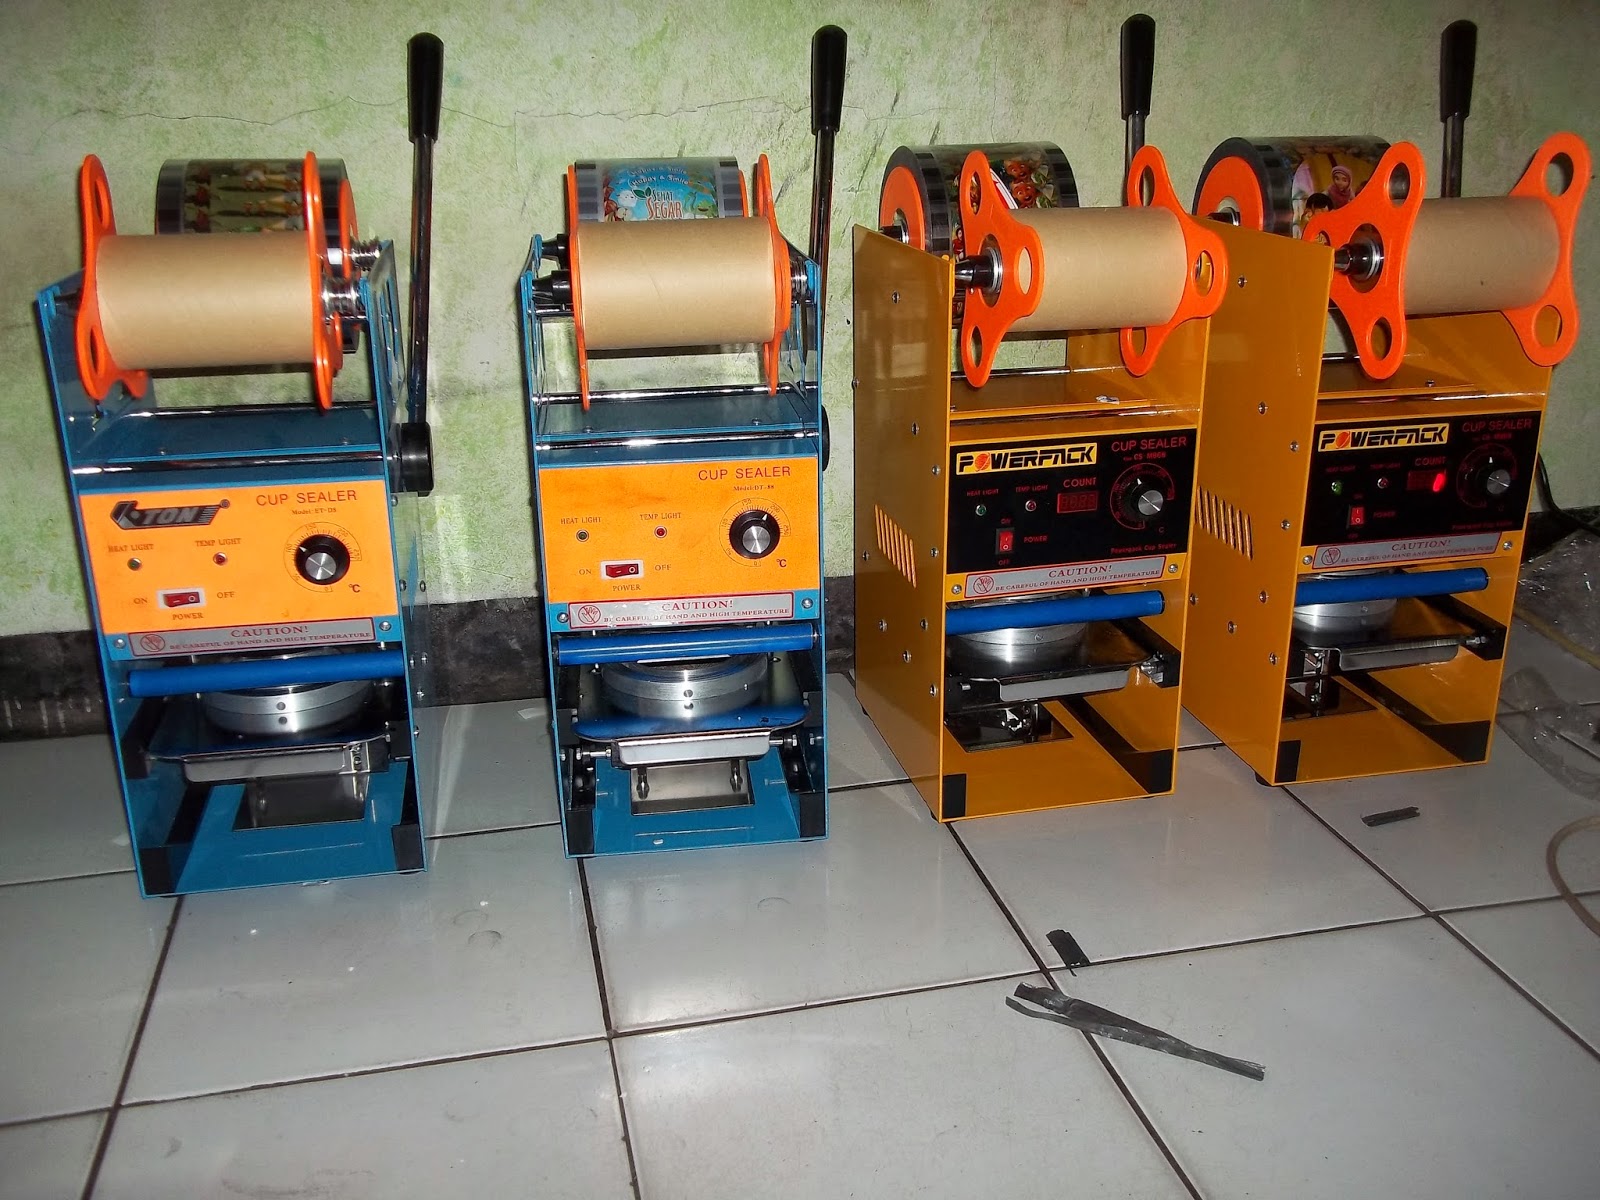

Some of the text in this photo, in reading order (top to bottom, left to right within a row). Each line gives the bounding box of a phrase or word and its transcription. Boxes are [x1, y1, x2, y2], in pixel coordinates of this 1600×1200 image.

[667, 174, 689, 185] Smile
[652, 189, 674, 201] SEHAT
[647, 197, 683, 219] SEGAR
[1461, 418, 1533, 433] CUP SEALER
[1321, 426, 1447, 450] POWERPACK
[1111, 436, 1187, 452] CUP SEALER
[959, 446, 1096, 472] POWERPACK
[1414, 456, 1447, 467] COUNT
[698, 466, 791, 481] CUP SEALER
[1032, 484, 1048, 492] LIGHT
[1063, 477, 1097, 488] COUNT
[256, 489, 357, 507] CUP SEALER
[966, 488, 999, 497] HEAT LIGHT
[560, 516, 602, 525] HEAT LIGHT
[640, 511, 682, 521] TEMP LIGHT
[195, 537, 241, 547] TEMP LIGHT
[1023, 535, 1048, 543] POWER
[108, 543, 154, 553] HEAT LIGHT
[1144, 544, 1156, 552] Cup
[1391, 540, 1451, 552] CAUTION!
[578, 568, 592, 576] ON
[654, 563, 672, 571] OFF
[1048, 565, 1112, 578] CAUTION!
[1005, 582, 1039, 590] CAREFUL
[1109, 570, 1160, 580] TEMPERATURE
[612, 584, 641, 592] POWER
[216, 591, 235, 599] OFF
[133, 597, 148, 605] ON
[662, 600, 733, 611] CAUTION!
[172, 612, 204, 621] POWER
[665, 611, 689, 620] HAND
[690, 610, 708, 619] AND
[709, 609, 730, 617] HIGH
[732, 607, 790, 617] TEMPERATURE
[231, 625, 309, 638] CAUTION!
[183, 641, 221, 650] CAREFUL
[236, 638, 262, 646] HAND
[284, 635, 307, 643] HIGH
[308, 631, 372, 641] TEMPERATURE
